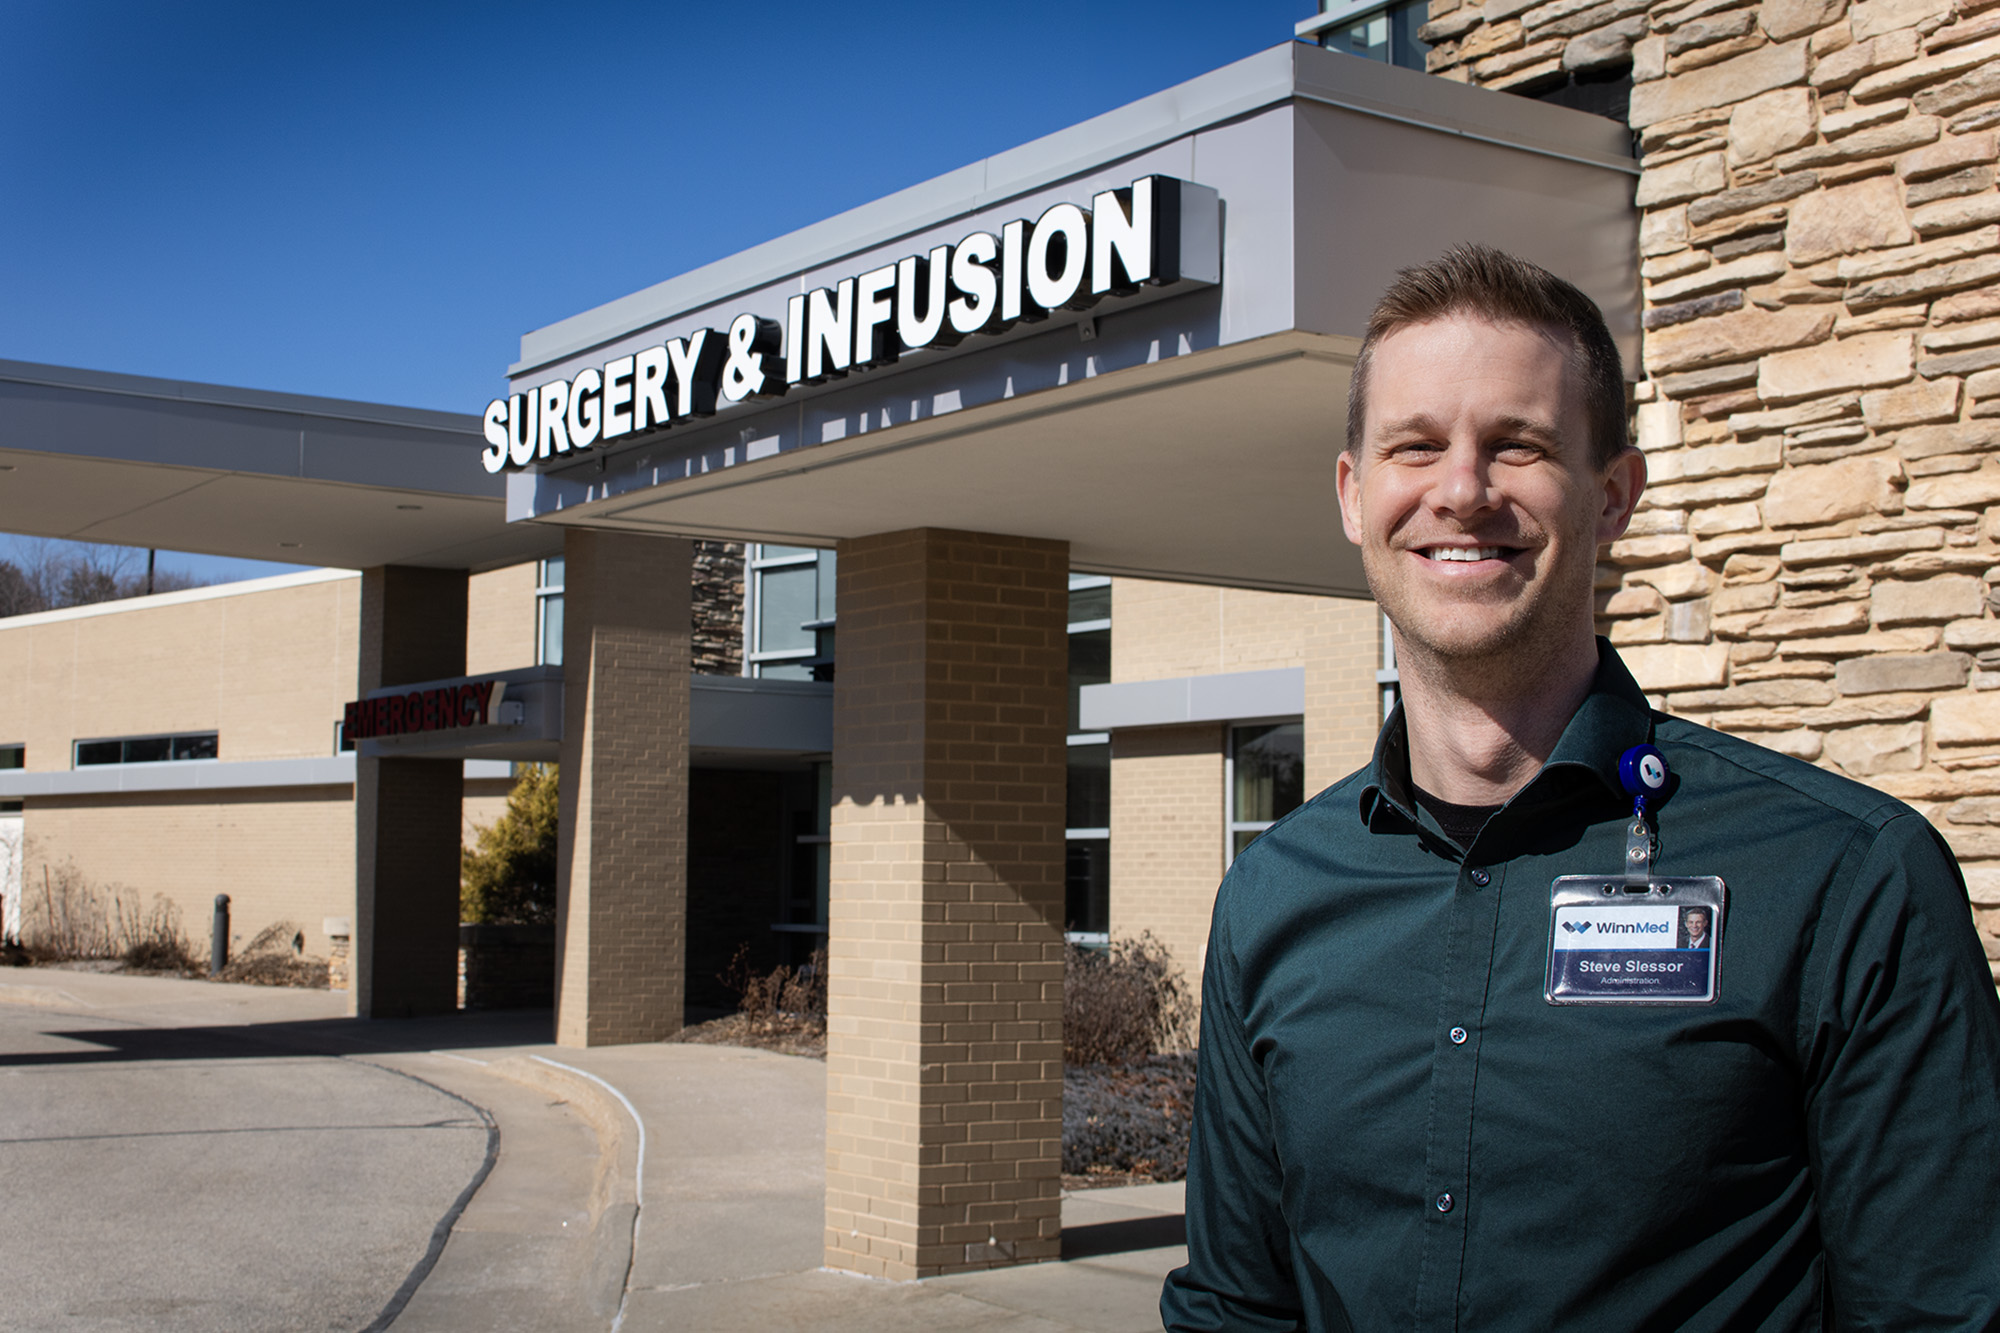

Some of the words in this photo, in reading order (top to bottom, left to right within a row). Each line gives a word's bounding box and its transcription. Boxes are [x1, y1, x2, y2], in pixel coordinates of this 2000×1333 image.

[482, 328, 707, 474] SURGERY
[722, 313, 766, 402] &
[786, 175, 1154, 384] INFUSION
[344, 680, 495, 740] EMERGENCY
[1596, 920, 1669, 934] WinnMed
[1579, 960, 1621, 973] Steve
[1625, 960, 1684, 973] Slessor
[1600, 976, 1660, 985] Administration
